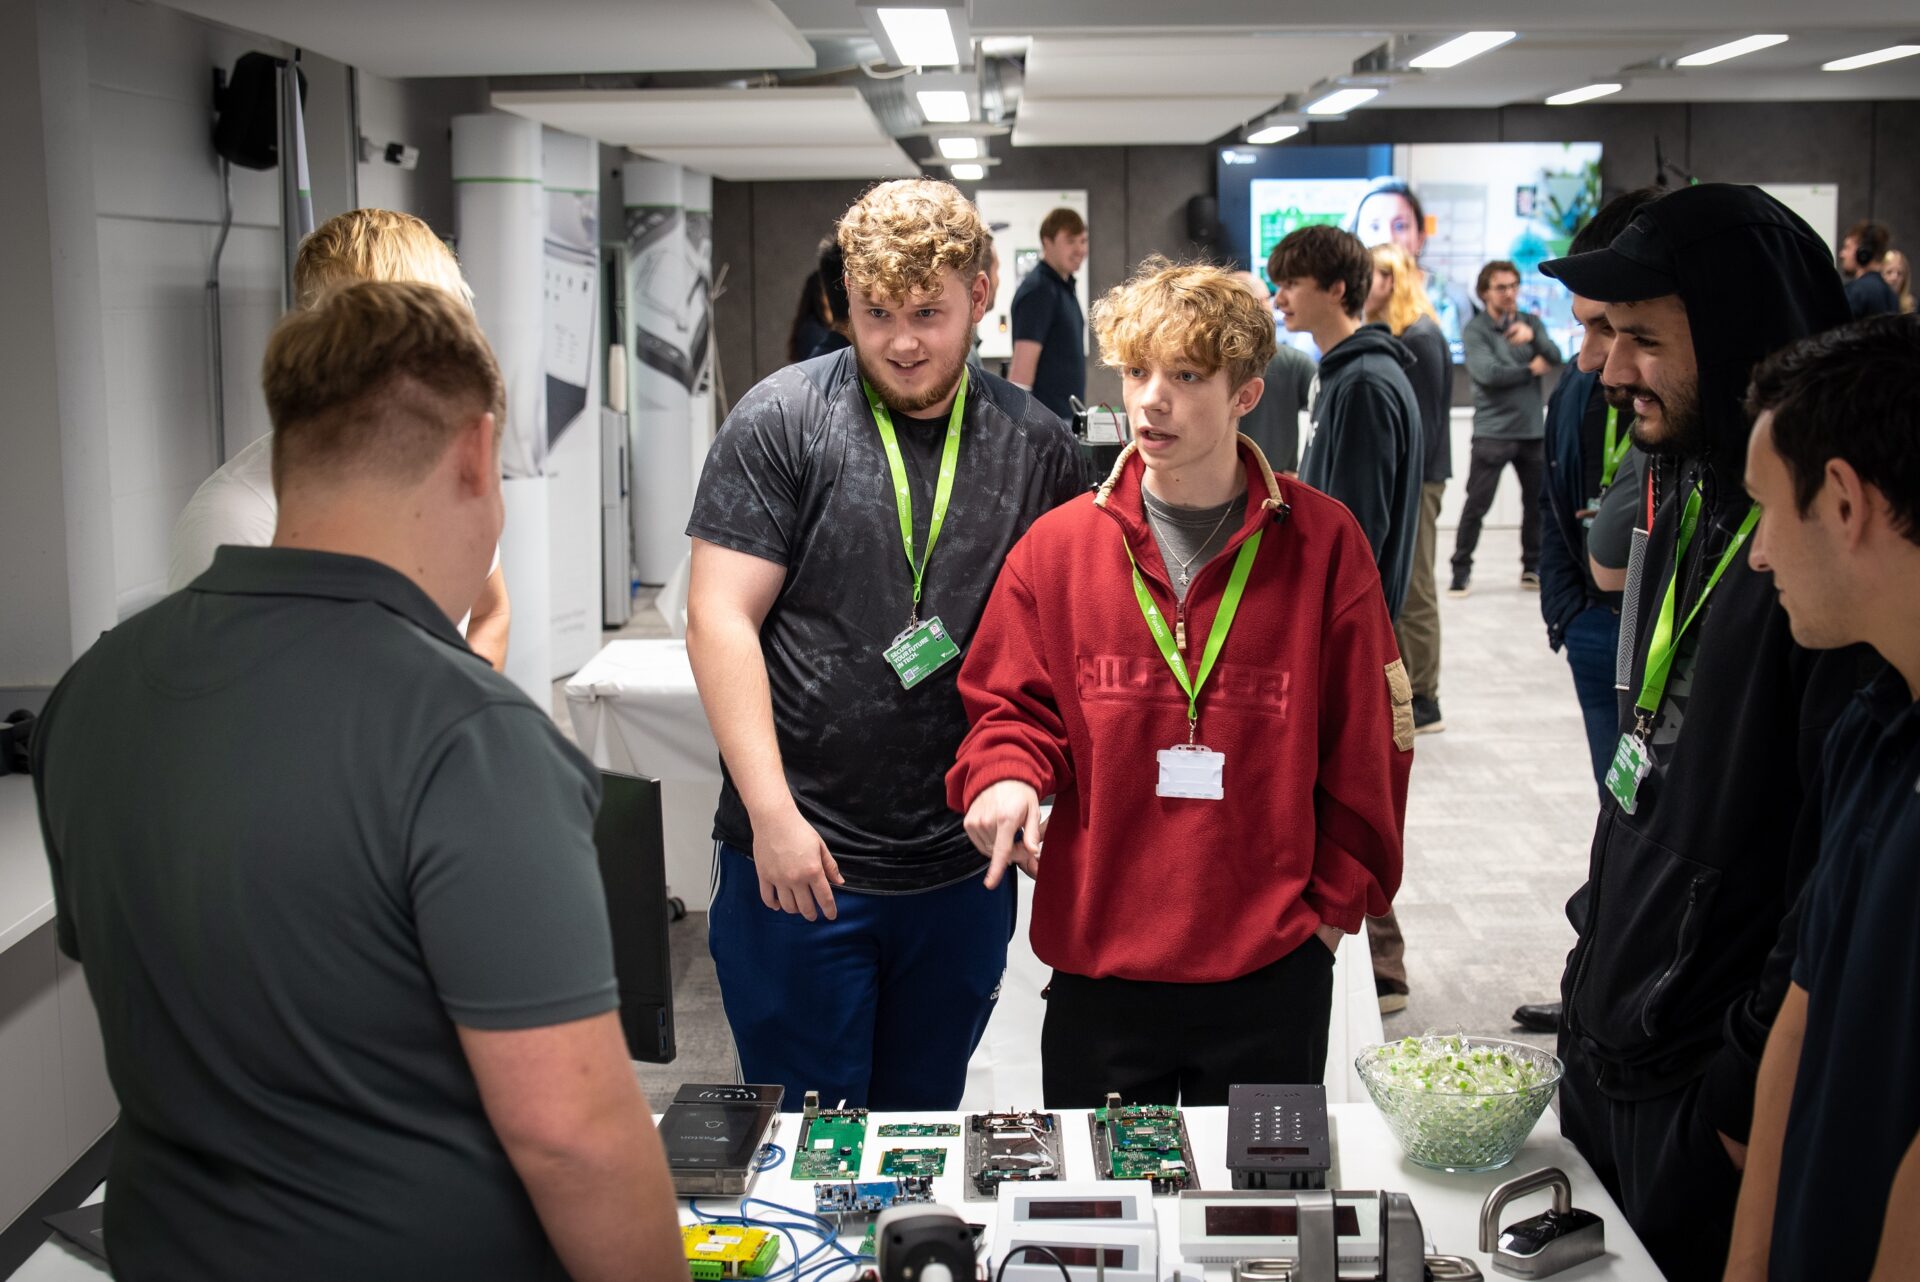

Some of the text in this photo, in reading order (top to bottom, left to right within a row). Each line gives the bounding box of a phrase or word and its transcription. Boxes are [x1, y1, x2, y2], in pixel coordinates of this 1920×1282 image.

[1151, 615, 1164, 638] Paxton
[890, 642, 911, 659] SECURE
[894, 650, 911, 664] YOUR
[907, 636, 930, 653] FUTURE
[1174, 661, 1188, 684] Paxton
